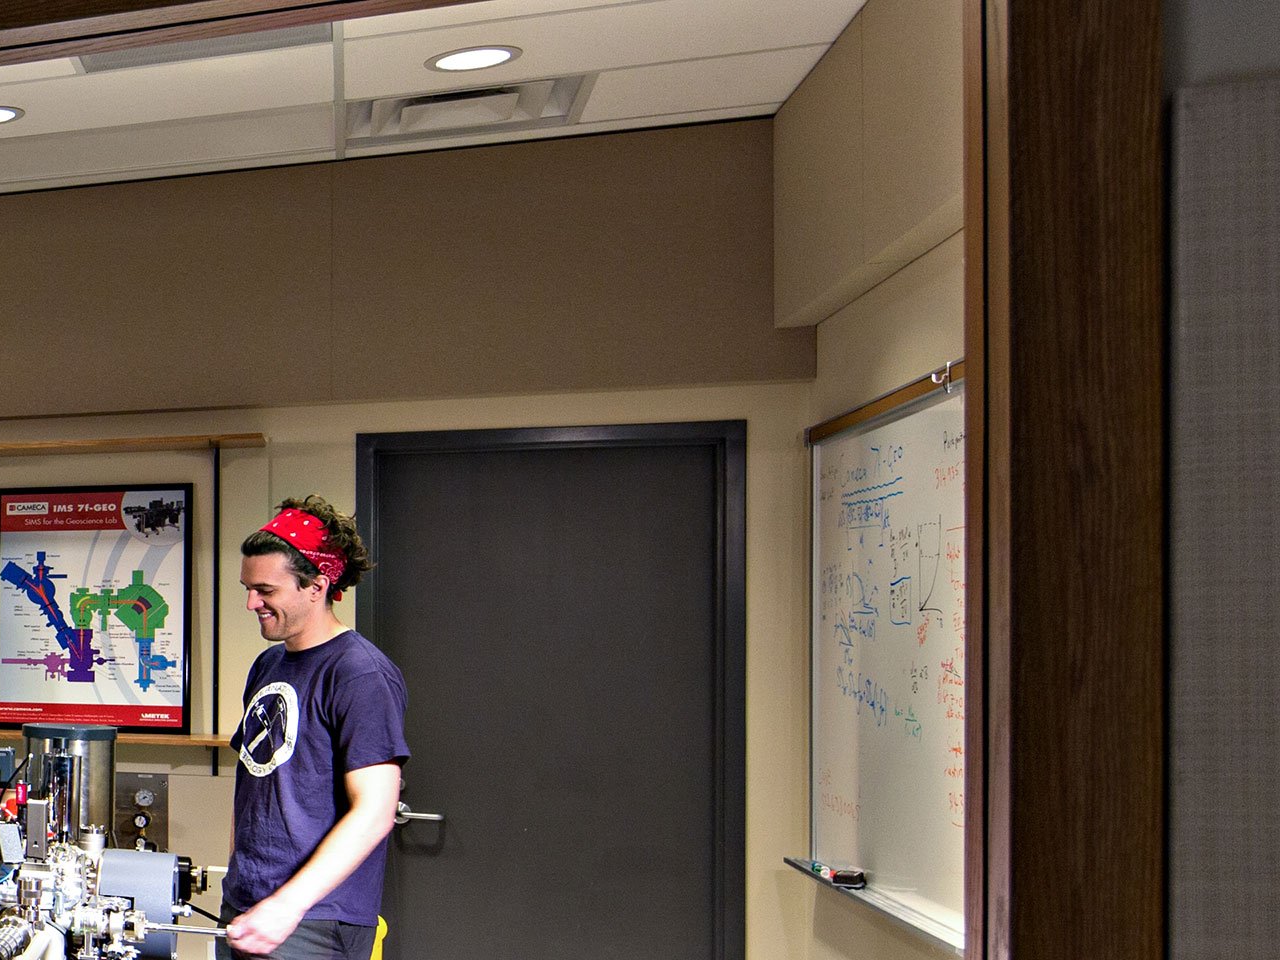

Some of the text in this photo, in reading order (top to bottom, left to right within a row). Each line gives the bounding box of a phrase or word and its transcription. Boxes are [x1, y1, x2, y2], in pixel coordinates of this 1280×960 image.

[53, 503, 117, 512] IMS 7f-GEO
[24, 516, 118, 526] SIMS for the Geoscience Lab
